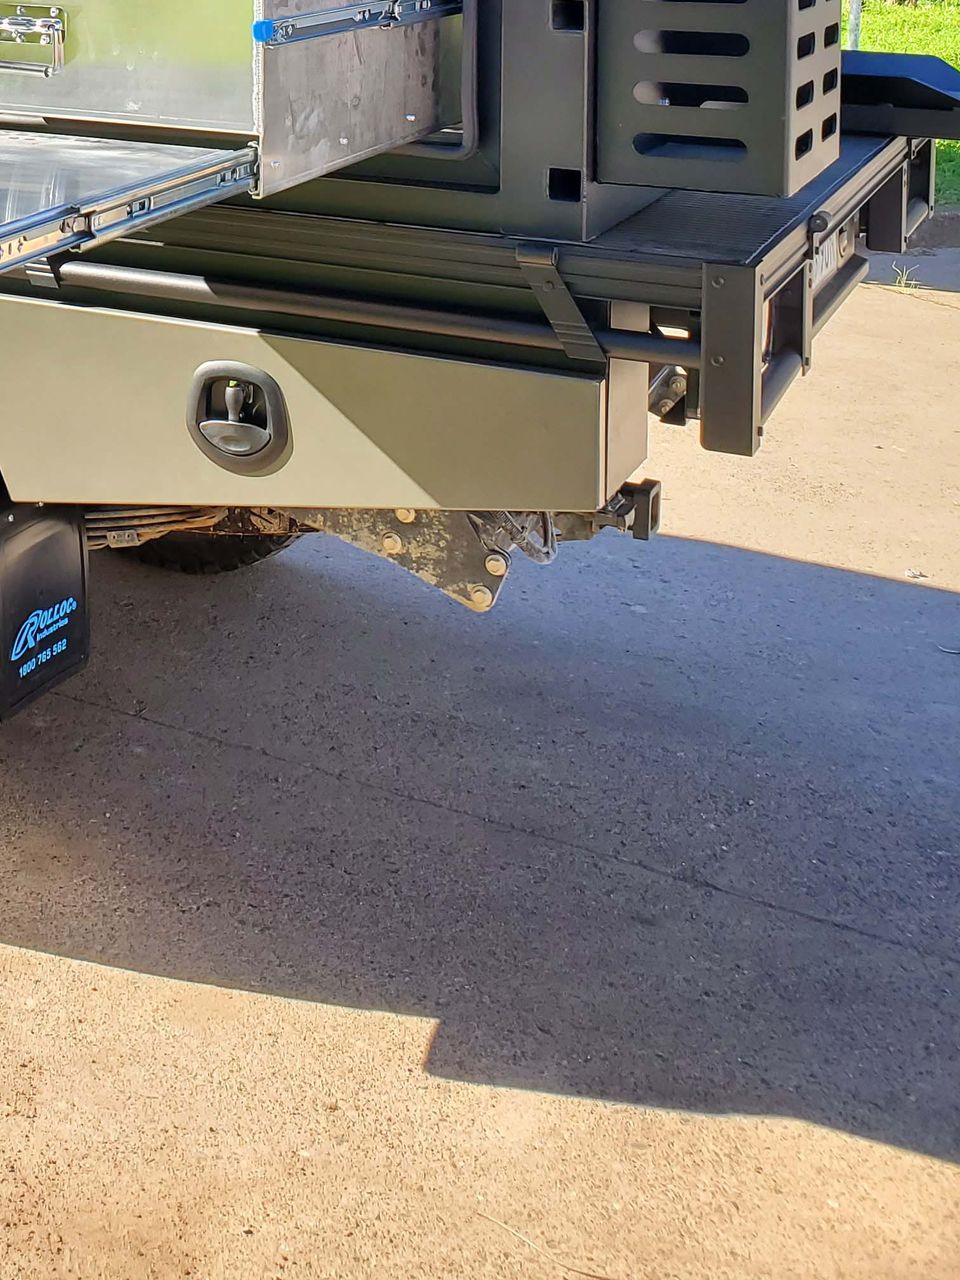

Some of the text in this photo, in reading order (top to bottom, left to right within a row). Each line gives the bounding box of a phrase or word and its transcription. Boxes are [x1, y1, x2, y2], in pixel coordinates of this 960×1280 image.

[19, 638, 67, 678] 1800 765 562
